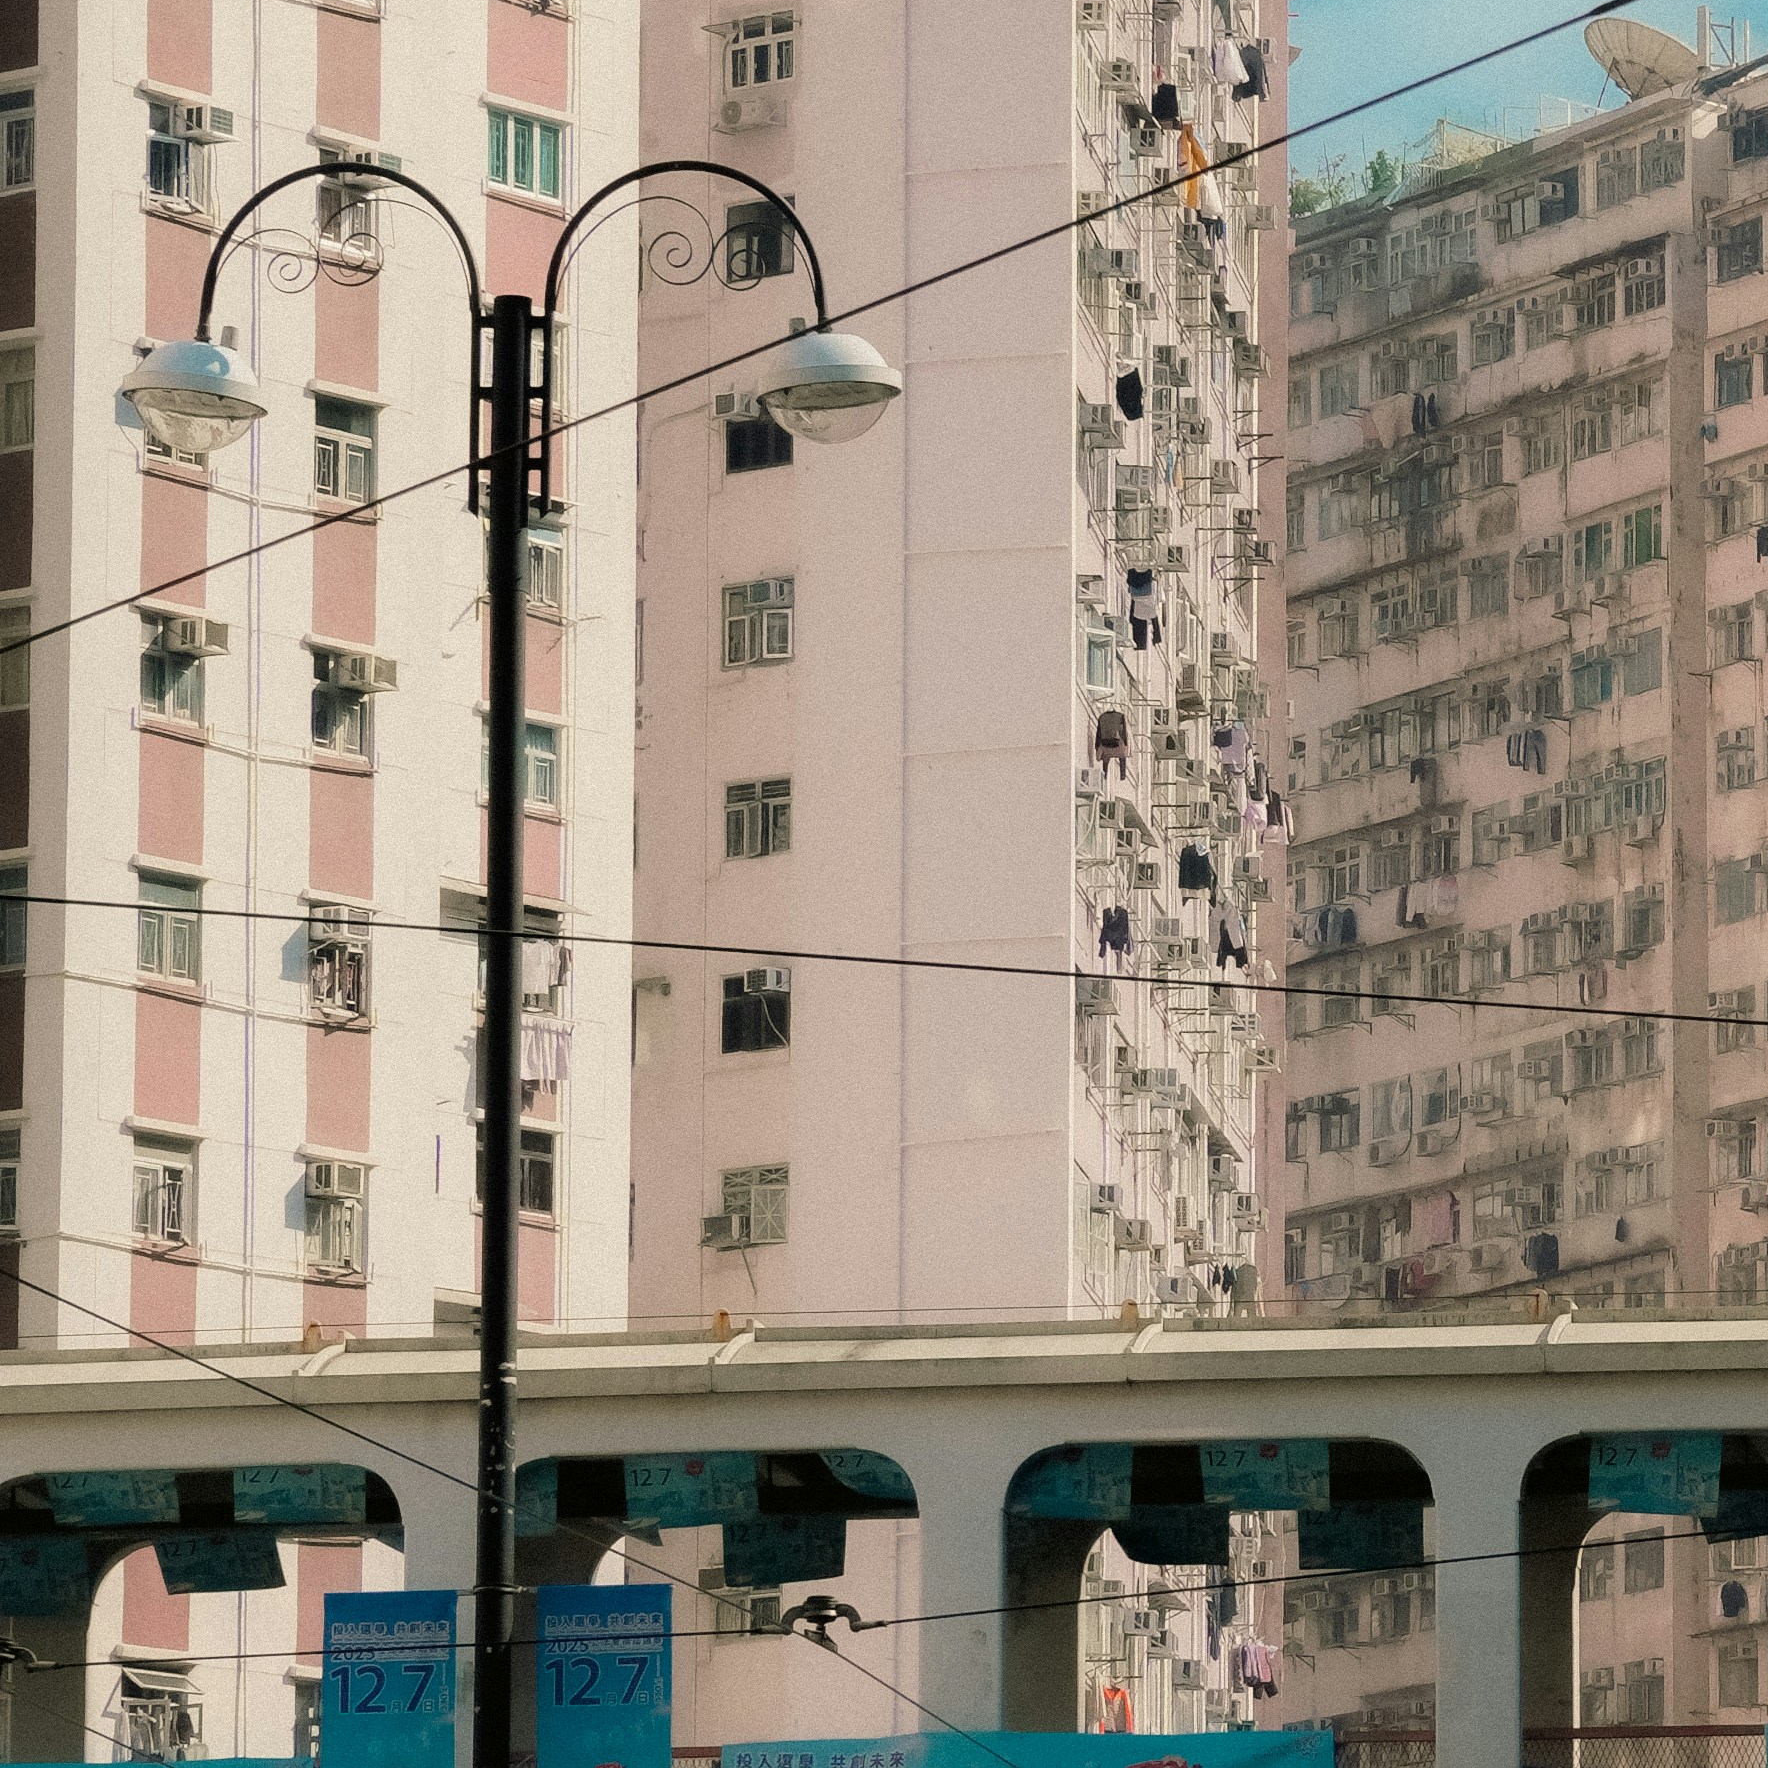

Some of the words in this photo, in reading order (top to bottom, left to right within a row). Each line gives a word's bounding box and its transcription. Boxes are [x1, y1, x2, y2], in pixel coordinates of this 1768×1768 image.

[1206, 1451, 1227, 1467] 12
[1234, 1451, 1245, 1468] 7
[1597, 1449, 1617, 1467] 12
[1625, 1450, 1637, 1467] 7
[630, 1468, 651, 1487] 12
[659, 1468, 671, 1487] 7
